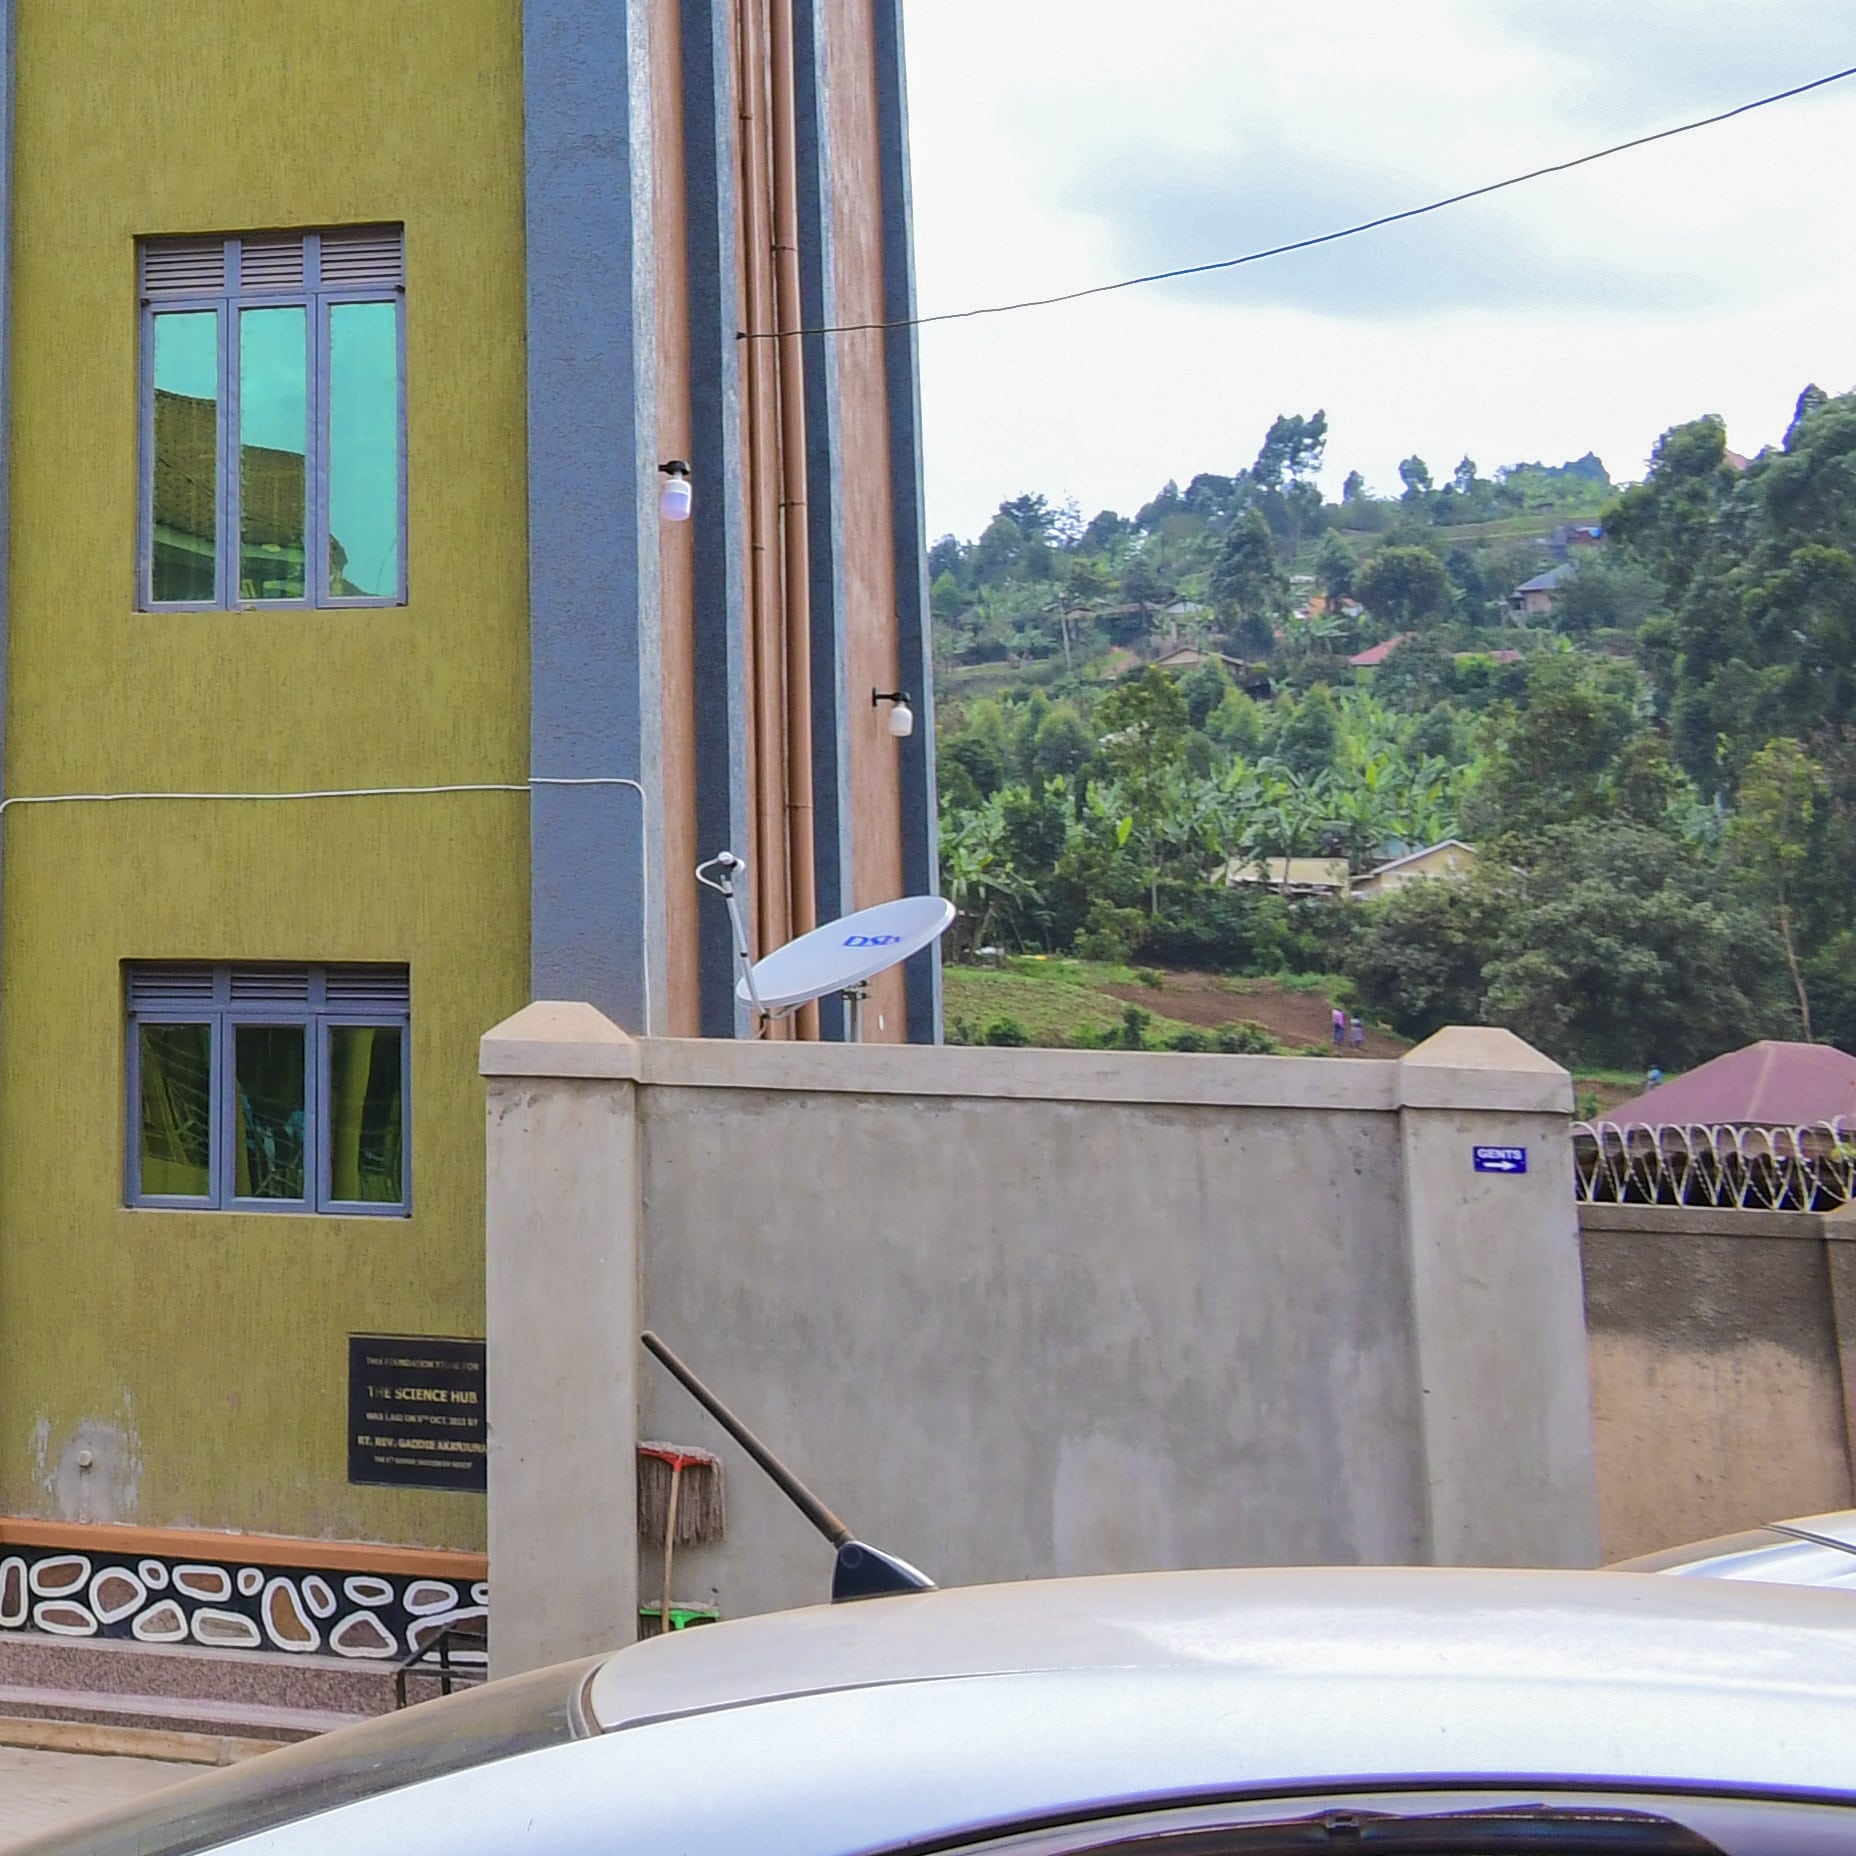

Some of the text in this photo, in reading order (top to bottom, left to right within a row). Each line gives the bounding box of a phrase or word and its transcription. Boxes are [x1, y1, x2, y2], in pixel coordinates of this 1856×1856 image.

[1477, 1148, 1522, 1160] GENTS
[367, 1386, 478, 1403] THE SCIENCE HUB
